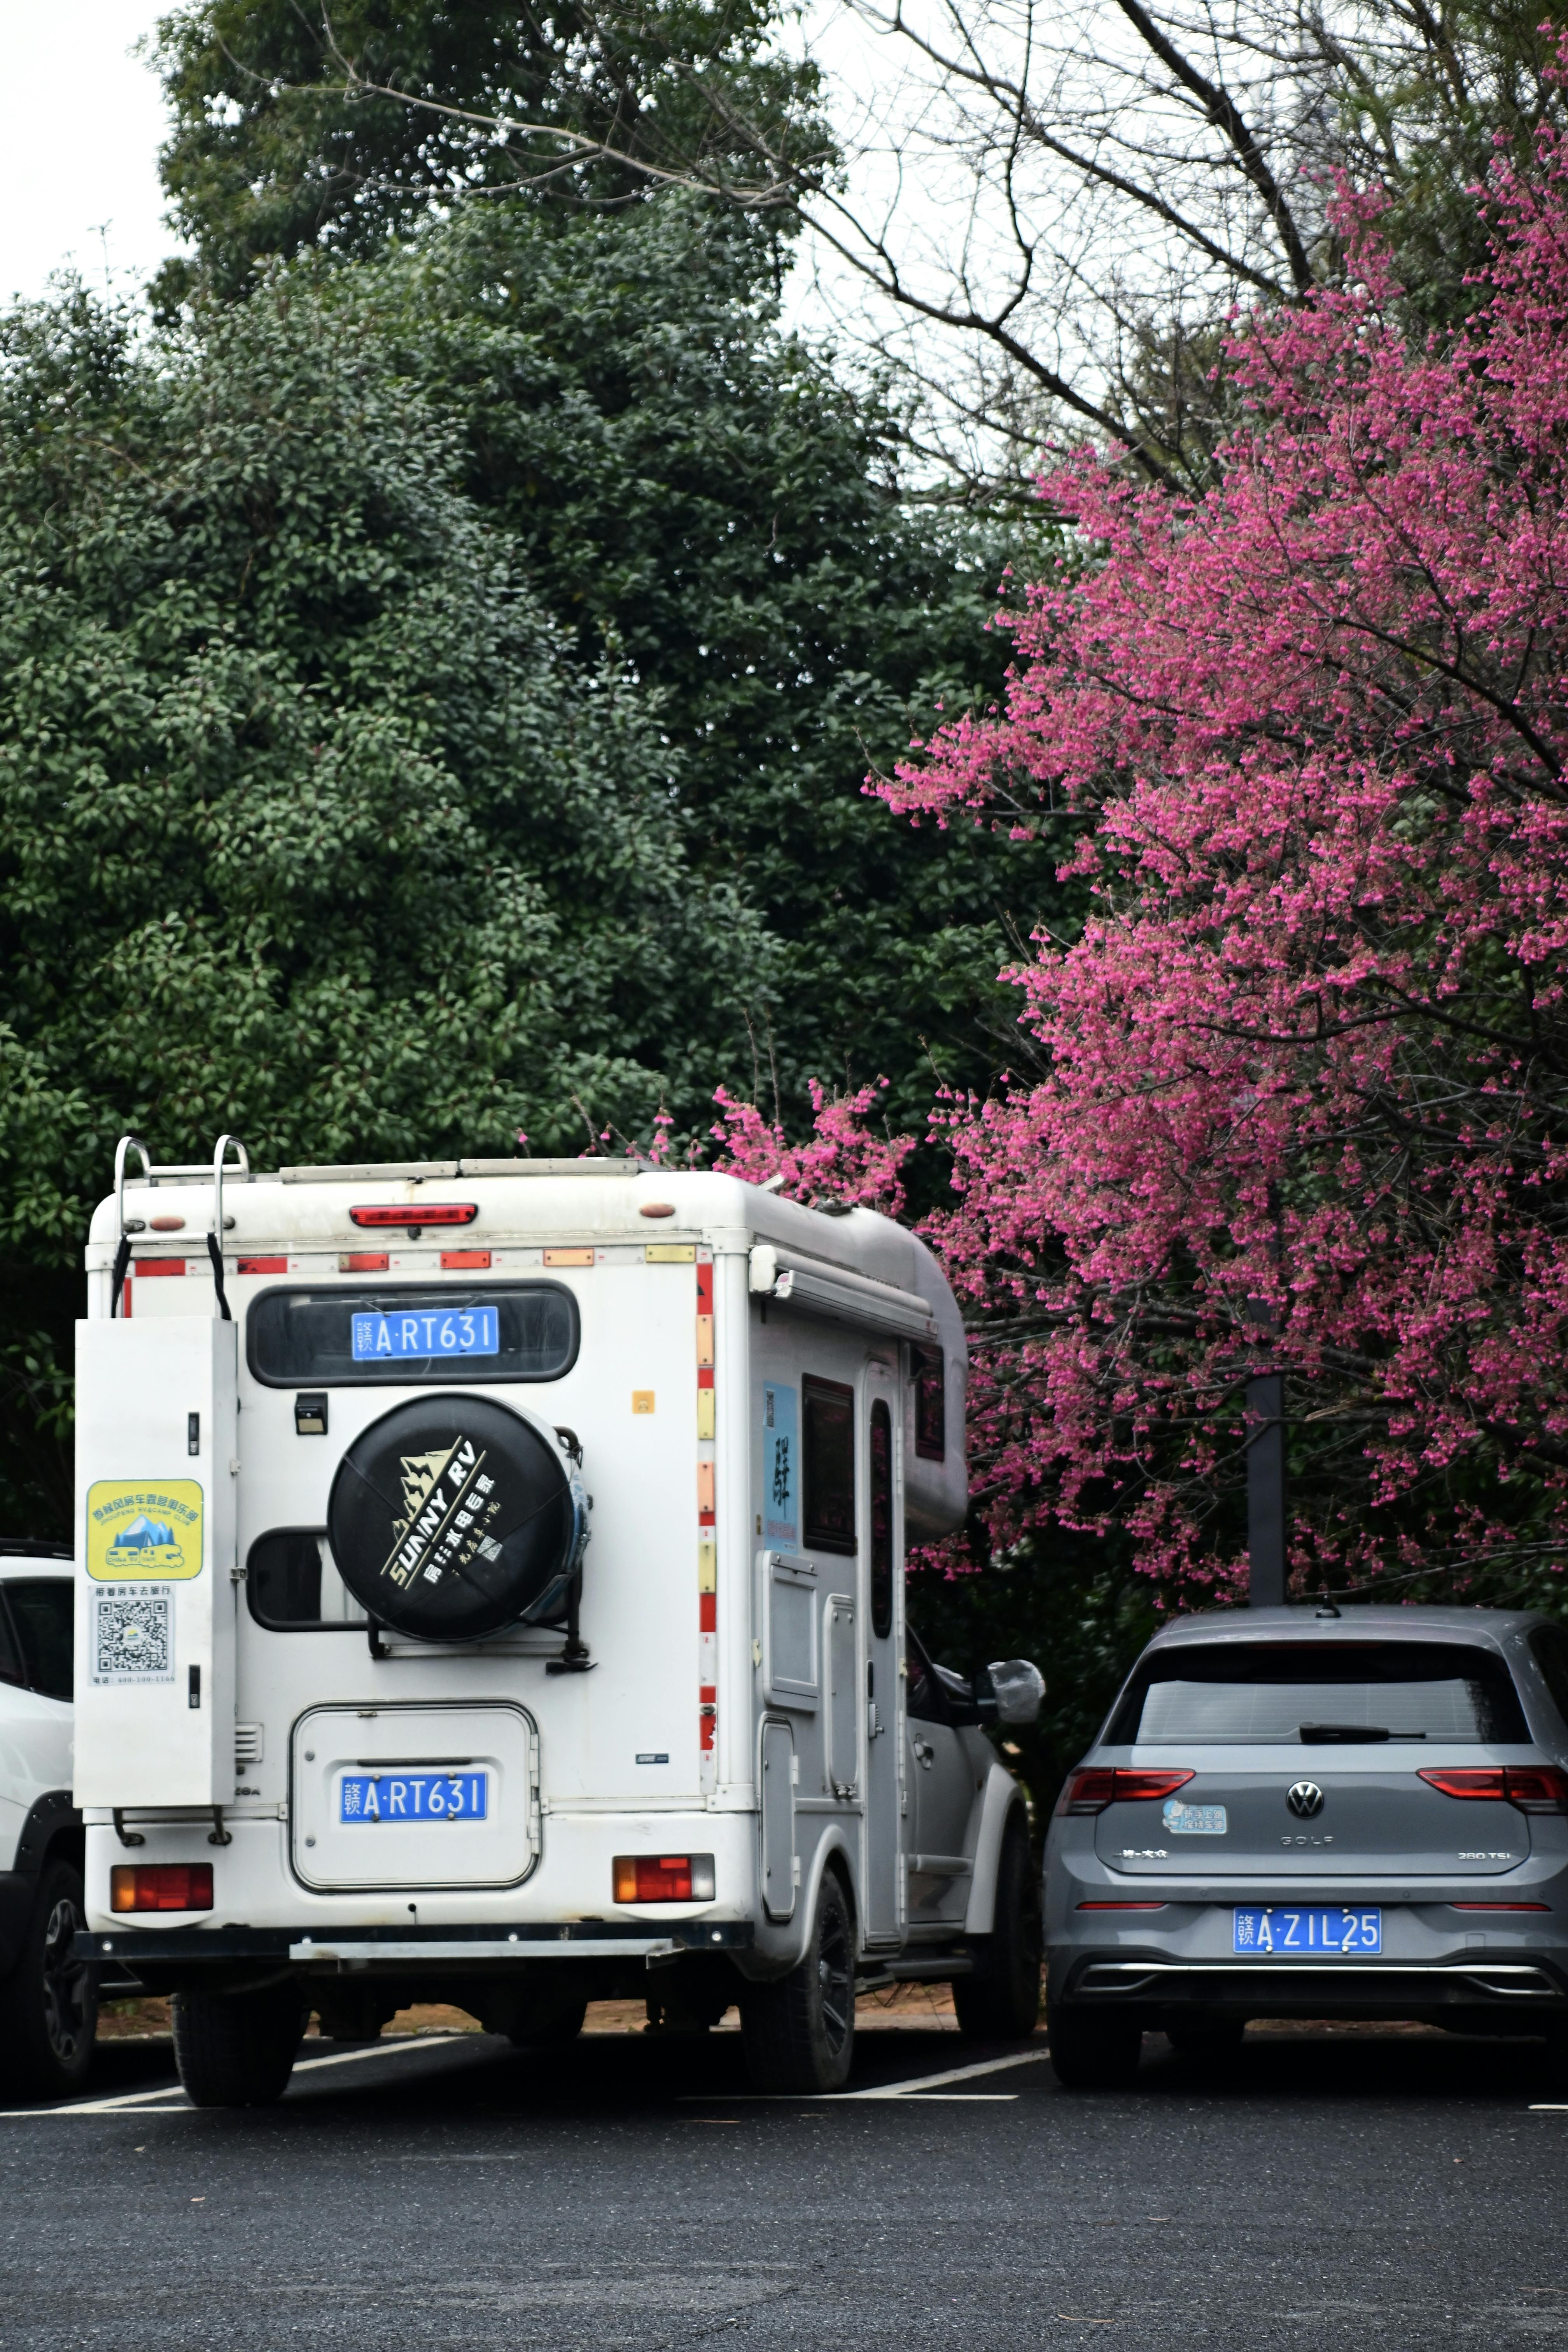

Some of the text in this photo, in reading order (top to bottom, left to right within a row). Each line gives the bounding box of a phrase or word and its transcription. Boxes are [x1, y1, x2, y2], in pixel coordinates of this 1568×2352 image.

[389, 1440, 476, 1586] SUNNY RV
[174, 1514, 191, 1526] CLUB
[1184, 1809, 1223, 1820] 新手上路
[1184, 1820, 1224, 1830] 保持车距
[1281, 1836, 1334, 1845] GOLF
